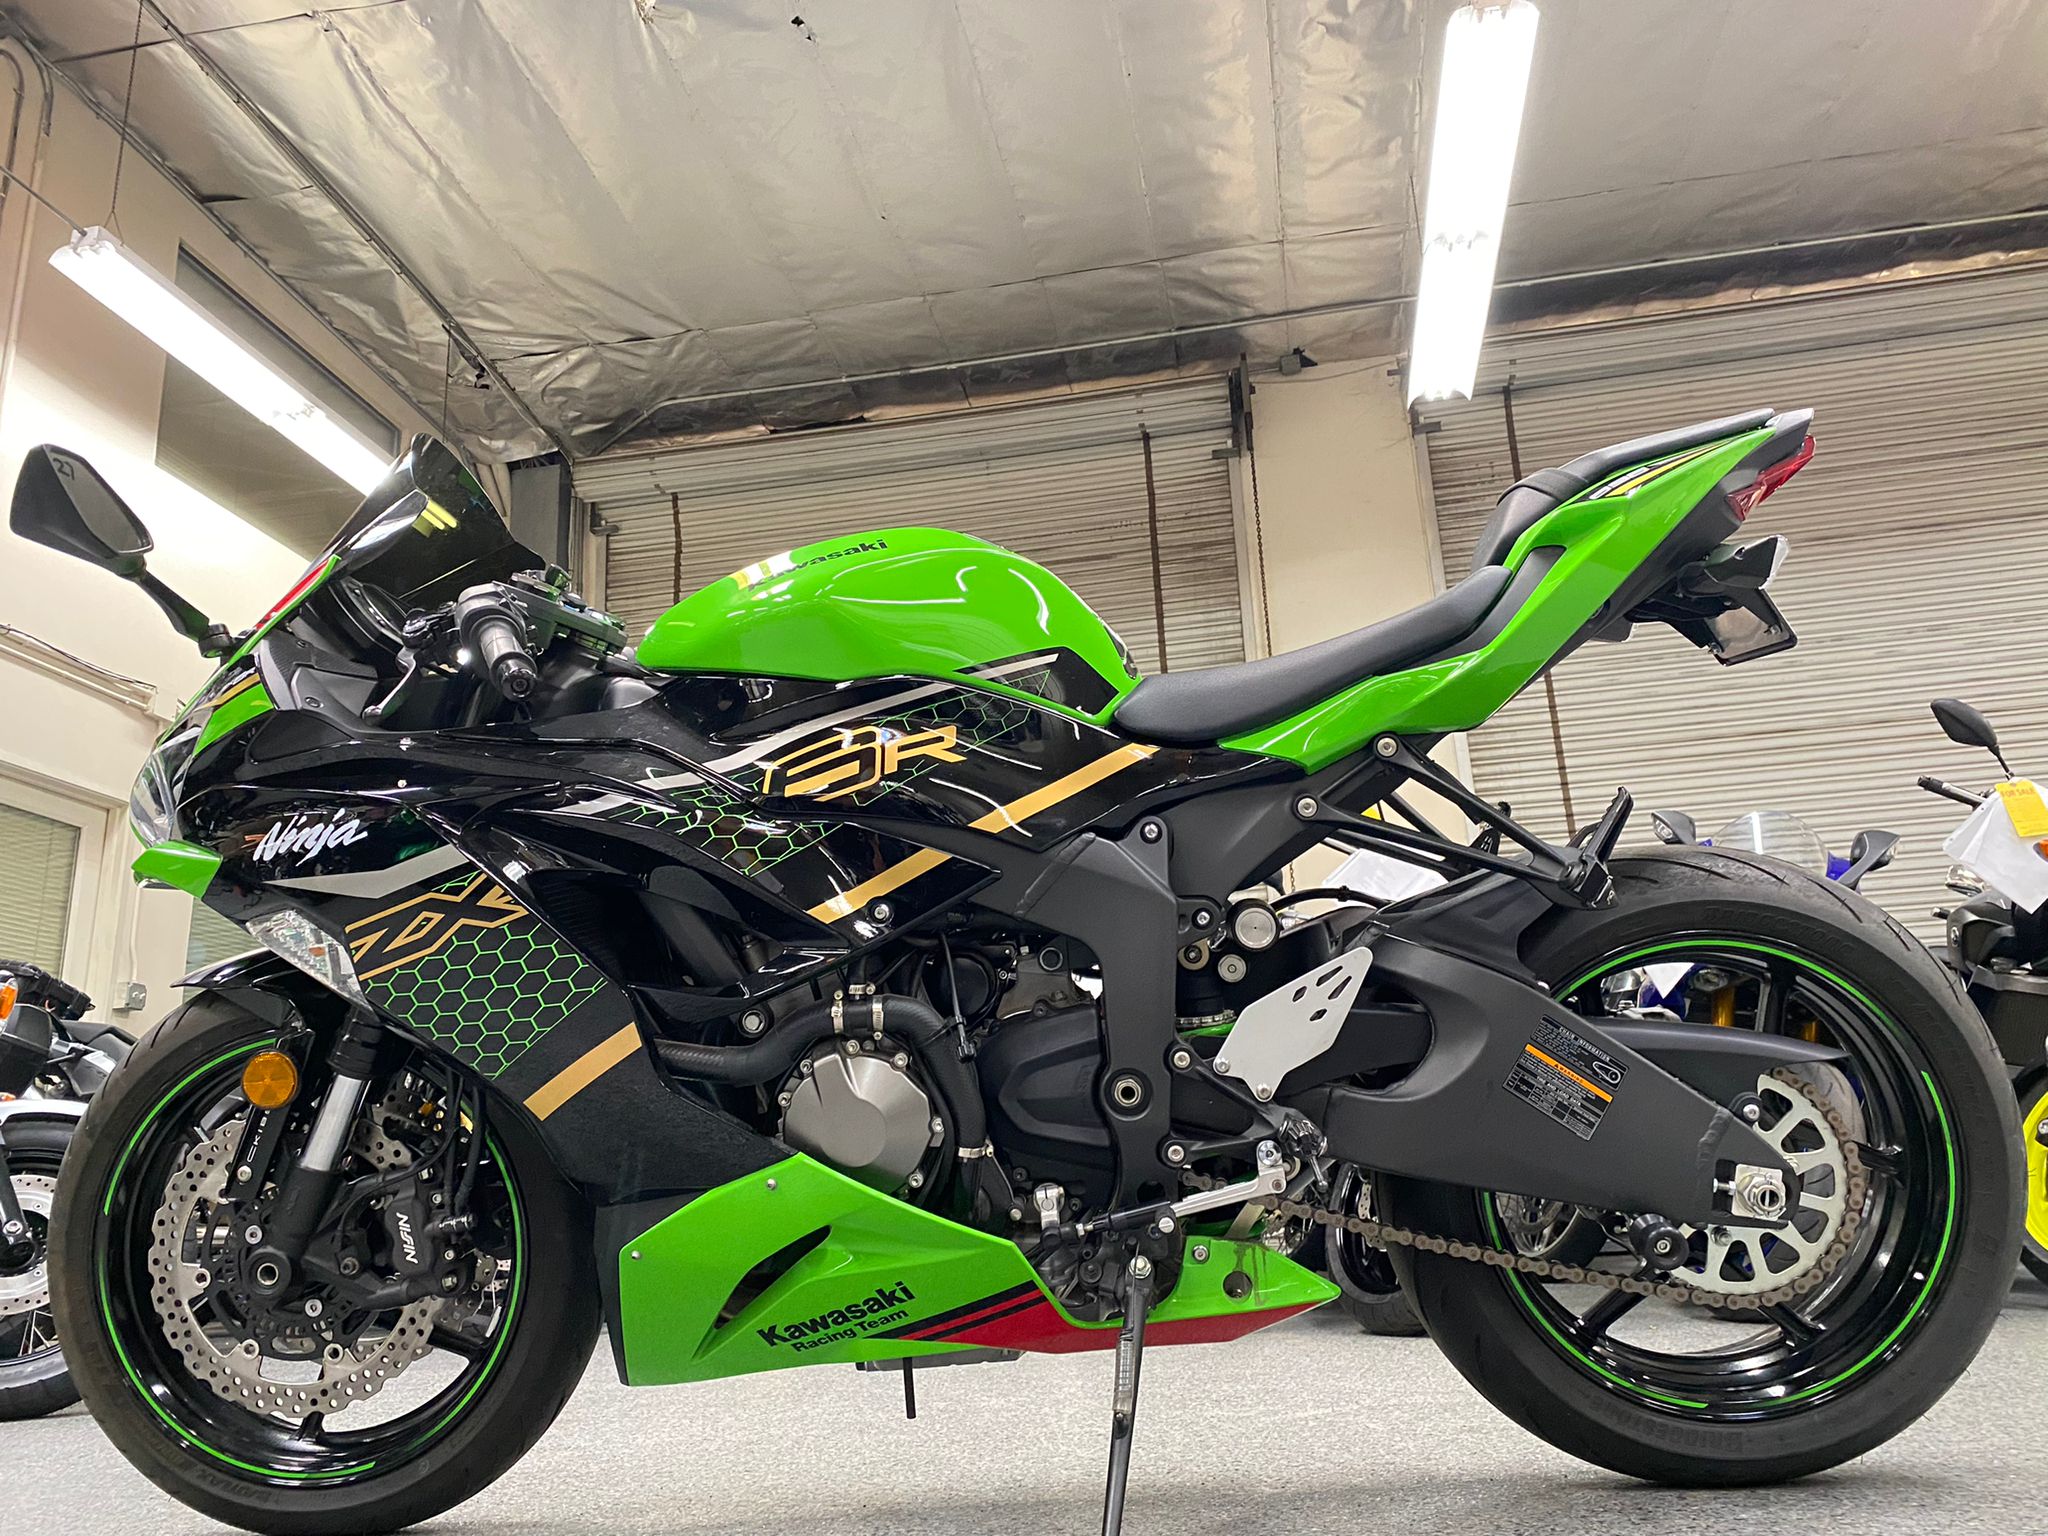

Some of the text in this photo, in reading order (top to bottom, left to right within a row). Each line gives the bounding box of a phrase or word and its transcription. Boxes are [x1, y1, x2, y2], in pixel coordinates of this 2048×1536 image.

[252, 808, 368, 867] Ninja
[756, 1280, 916, 1347] Kawasaki
[790, 1310, 909, 1352] Racing Team
